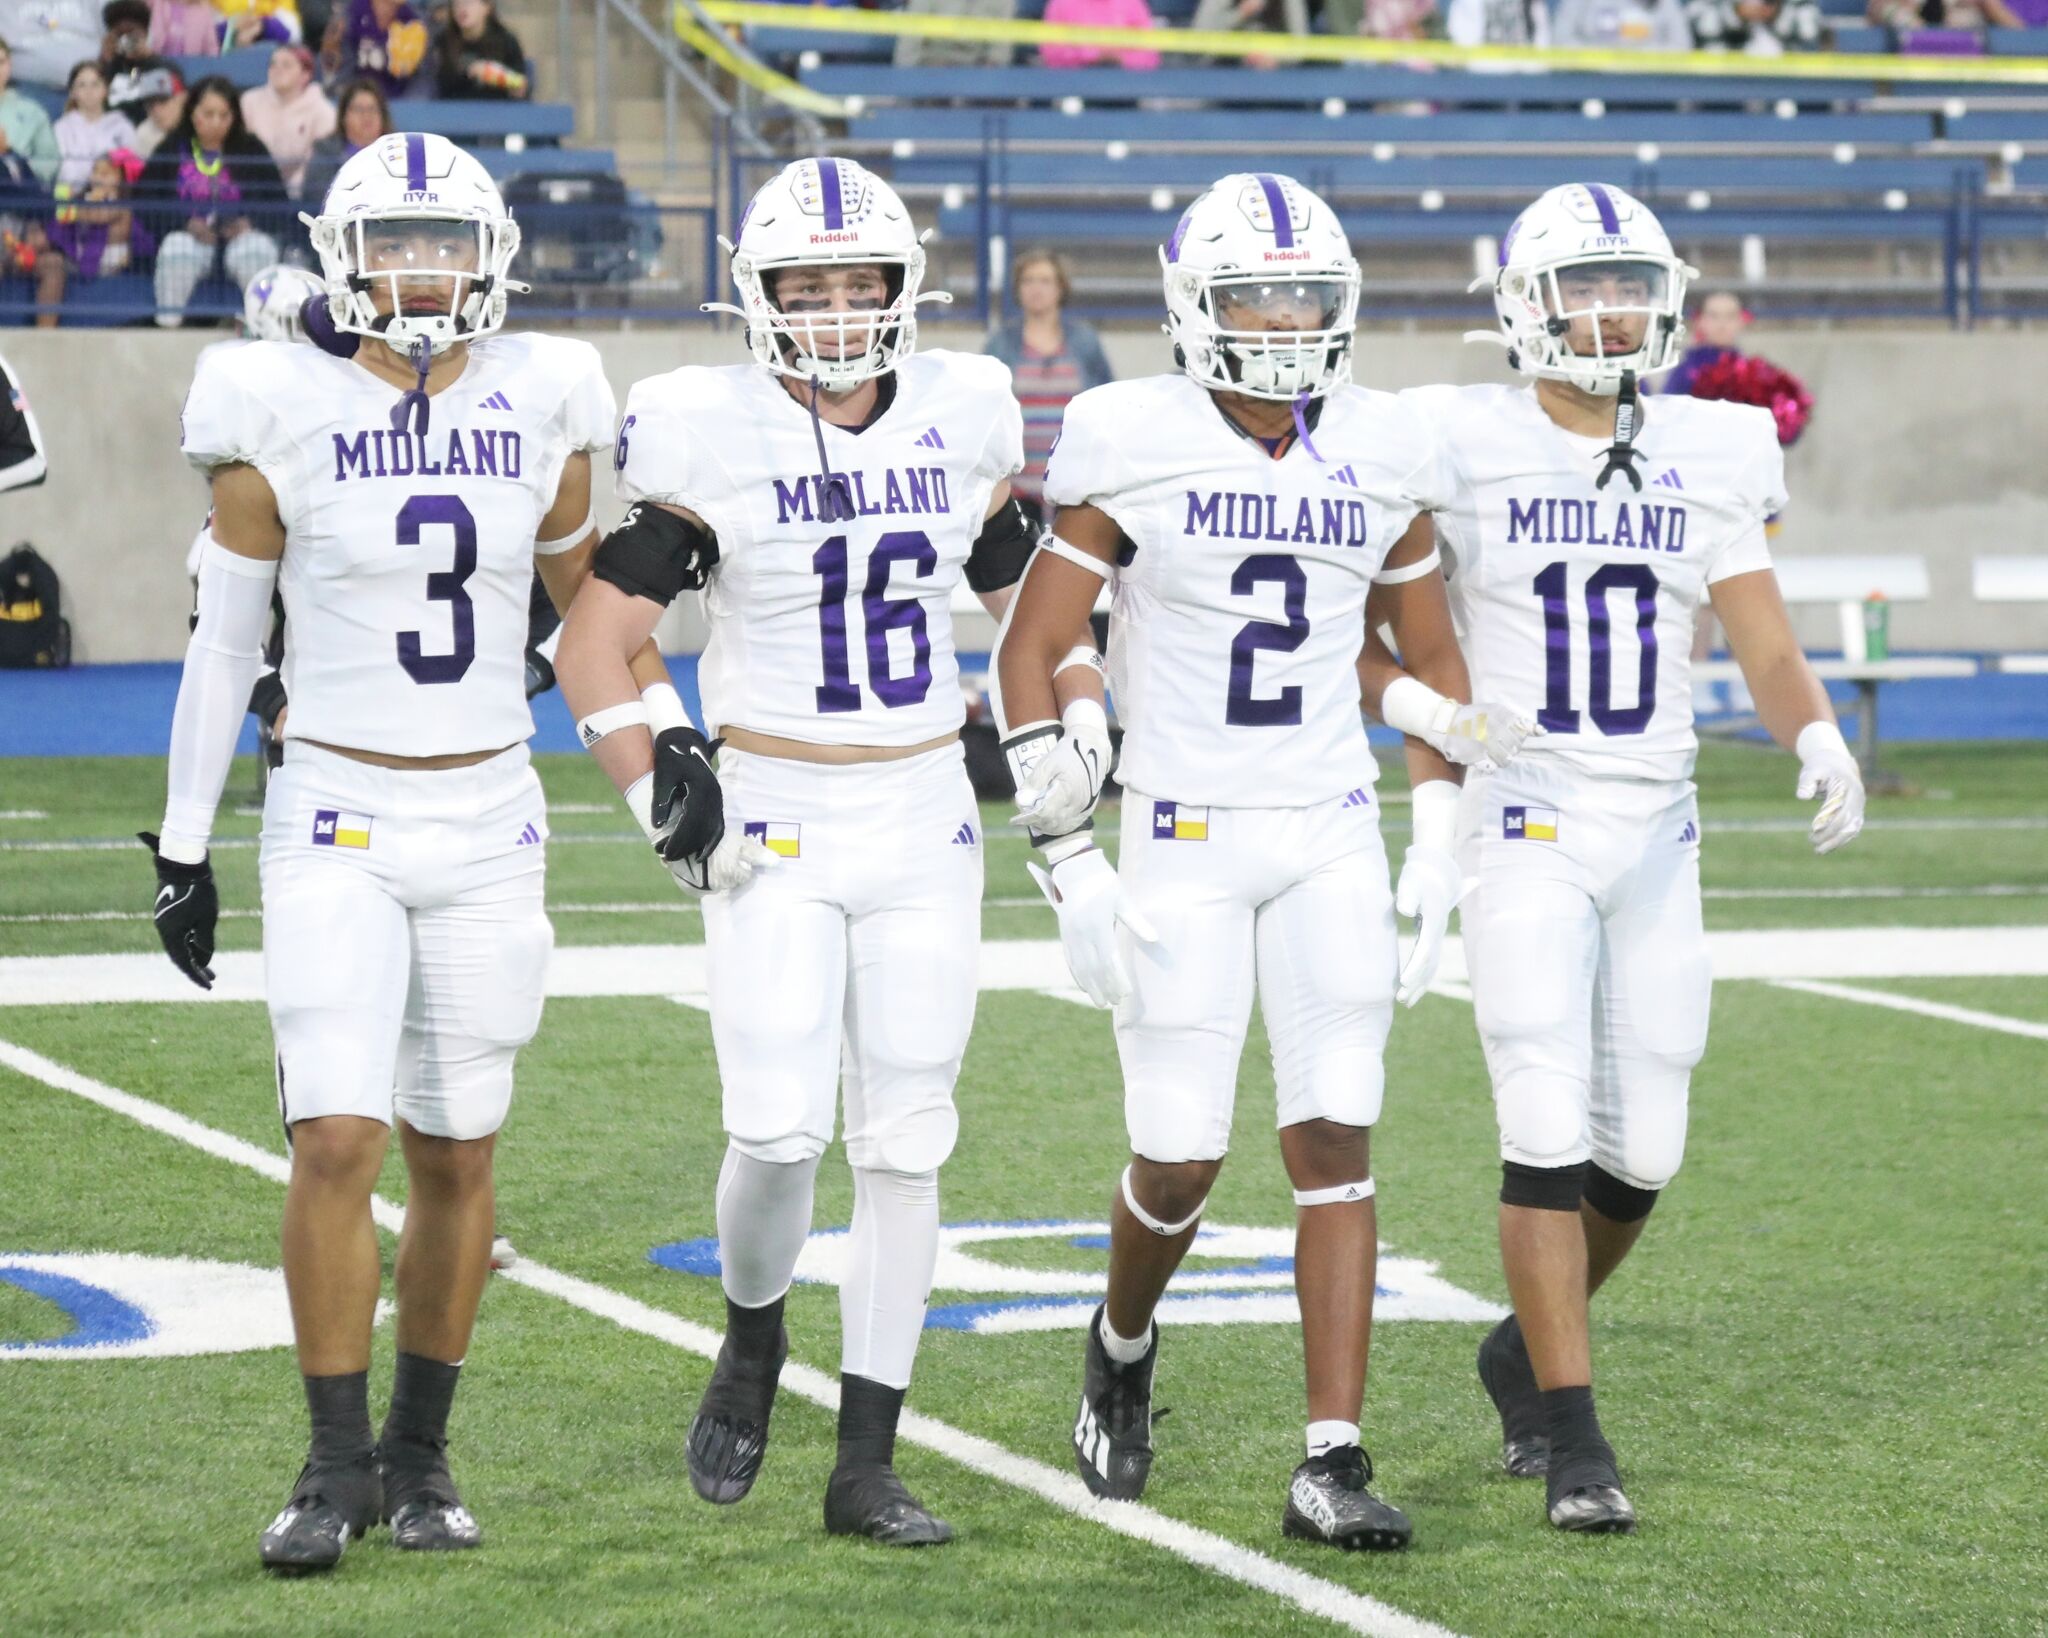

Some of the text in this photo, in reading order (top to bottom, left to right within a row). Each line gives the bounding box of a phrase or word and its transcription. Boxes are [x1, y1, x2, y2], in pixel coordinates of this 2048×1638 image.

[809, 232, 859, 245] Riddell
[332, 429, 521, 481] MIDLAND
[1183, 491, 1367, 547] MIDLAND
[1507, 498, 1687, 552] MIDLAND
[395, 495, 477, 685] 3
[812, 530, 937, 714] 16
[1225, 554, 1310, 727] 2
[1533, 561, 1660, 737] 10
